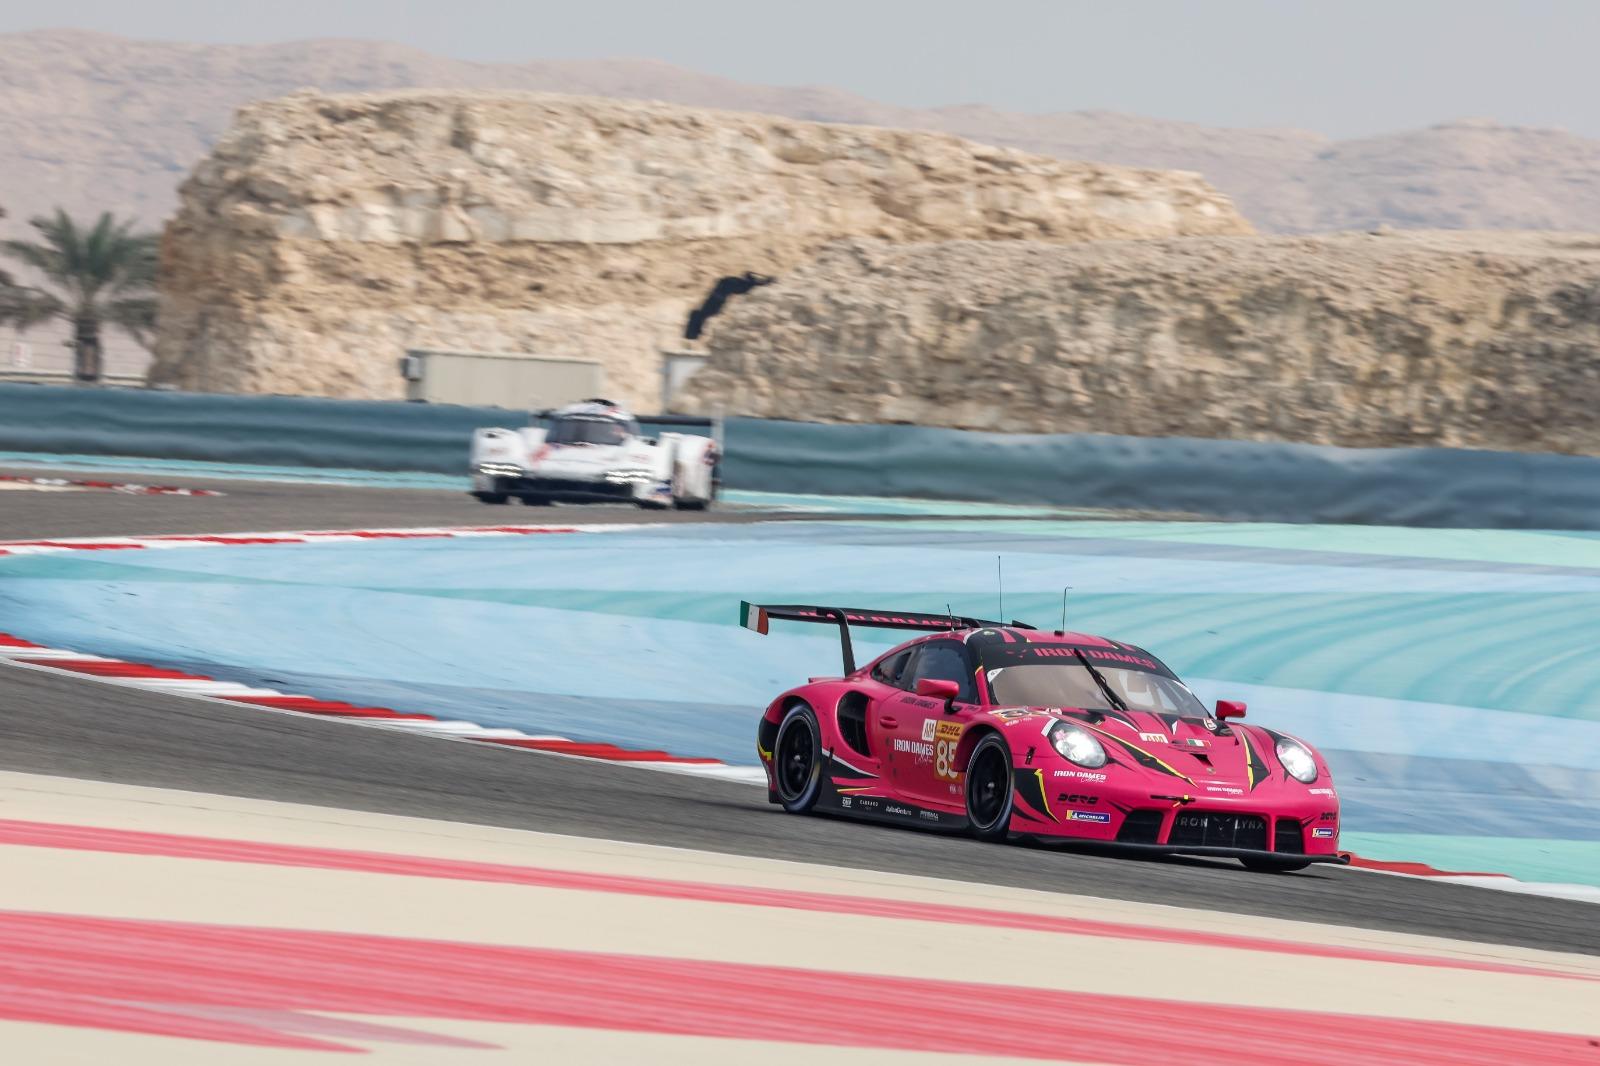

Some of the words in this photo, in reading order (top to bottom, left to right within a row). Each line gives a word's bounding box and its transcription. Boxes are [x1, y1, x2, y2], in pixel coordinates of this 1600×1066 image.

[1088, 650, 1157, 670] DAMES
[941, 724, 961, 736] DHL
[894, 738, 911, 753] IRON
[911, 740, 934, 756] DAMES
[1076, 771, 1107, 780] DAMES
[1175, 816, 1208, 828] IRON
[1234, 818, 1264, 830] LYNX
